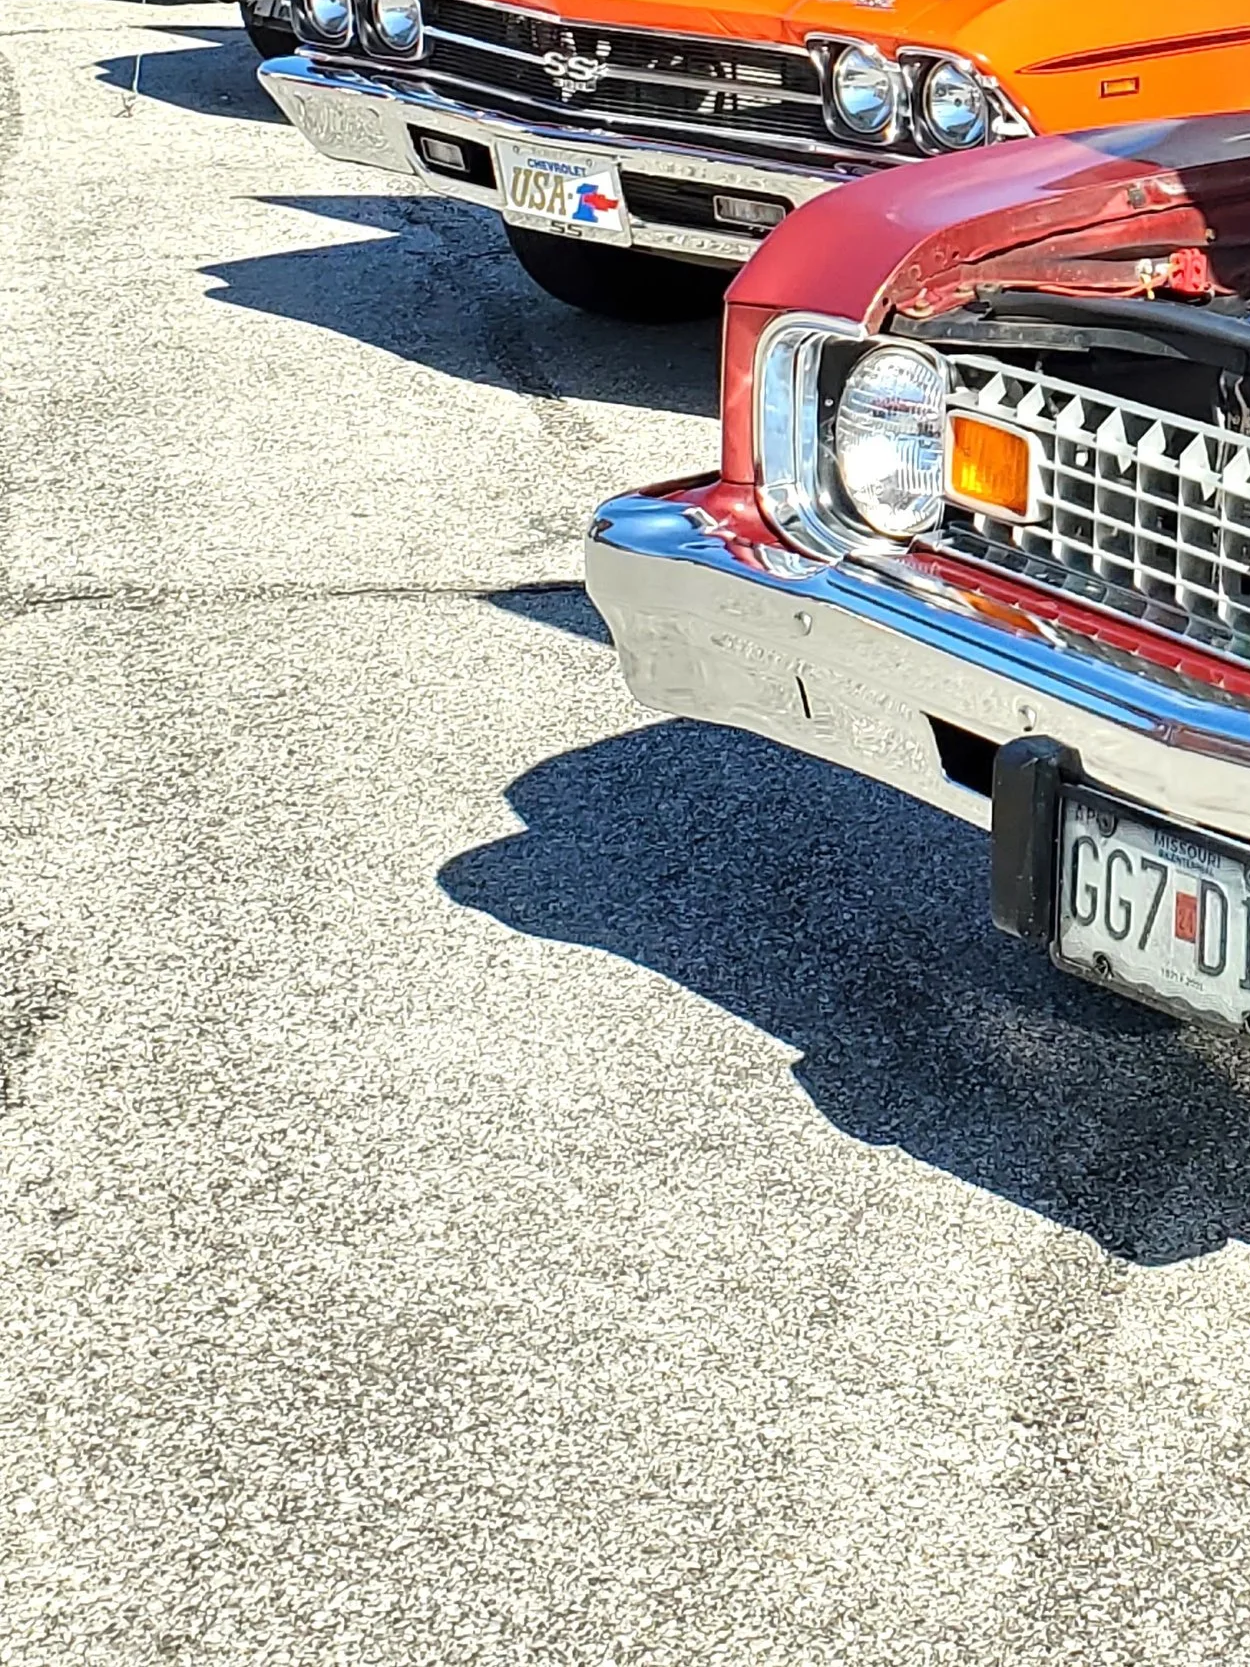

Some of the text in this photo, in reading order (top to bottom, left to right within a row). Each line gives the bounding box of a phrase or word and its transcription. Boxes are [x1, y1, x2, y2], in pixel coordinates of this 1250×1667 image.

[543, 51, 599, 81] SS
[527, 158, 587, 176] CHEVROLET
[550, 221, 583, 237] SS
[1154, 834, 1221, 869] MISSOURI
[1070, 836, 1168, 951] GG7
